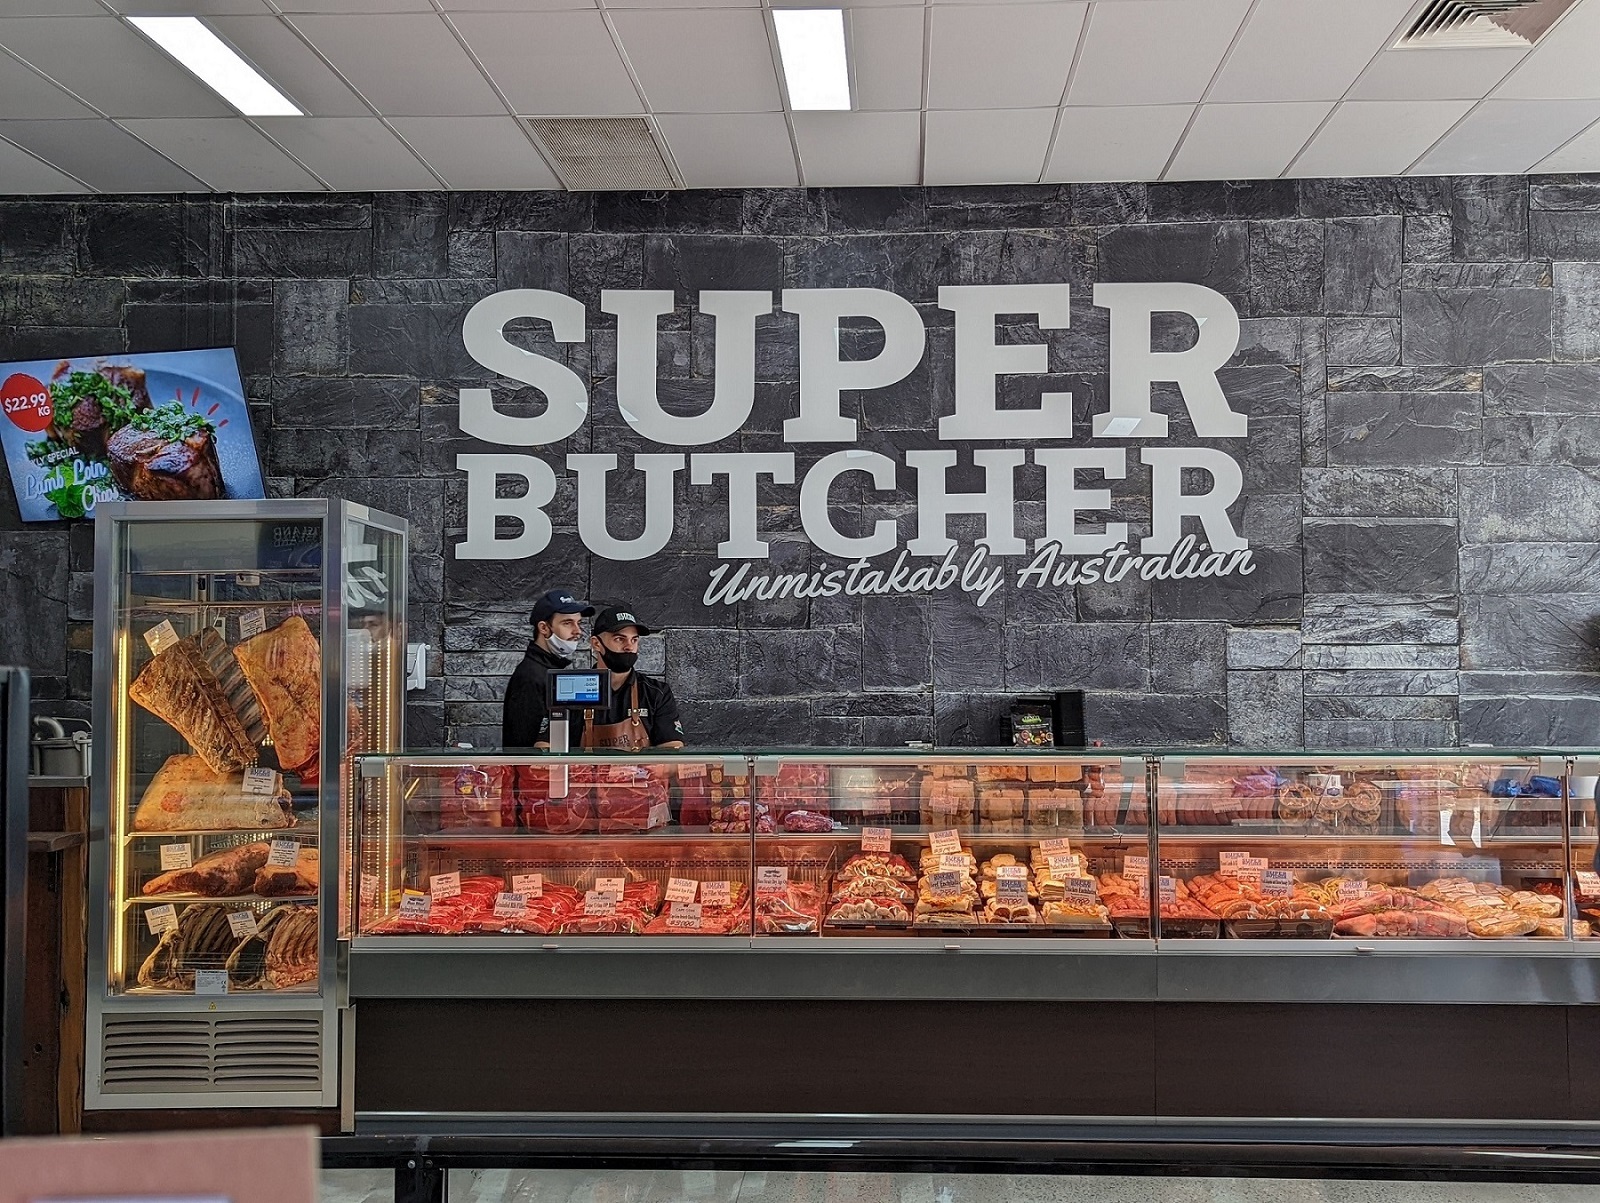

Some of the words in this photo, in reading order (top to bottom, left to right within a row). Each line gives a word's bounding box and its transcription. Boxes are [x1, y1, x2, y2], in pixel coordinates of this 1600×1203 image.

[458, 282, 1248, 447] SUPER
[5, 392, 47, 413] $22.99
[38, 405, 51, 417] KG
[47, 446, 80, 463] SPECIAL
[25, 466, 65, 500] Lamb
[72, 458, 108, 485] Loin
[455, 446, 1250, 560] BUTCHER
[703, 542, 1005, 607] Unmistakably
[1017, 534, 1256, 590] Australian
